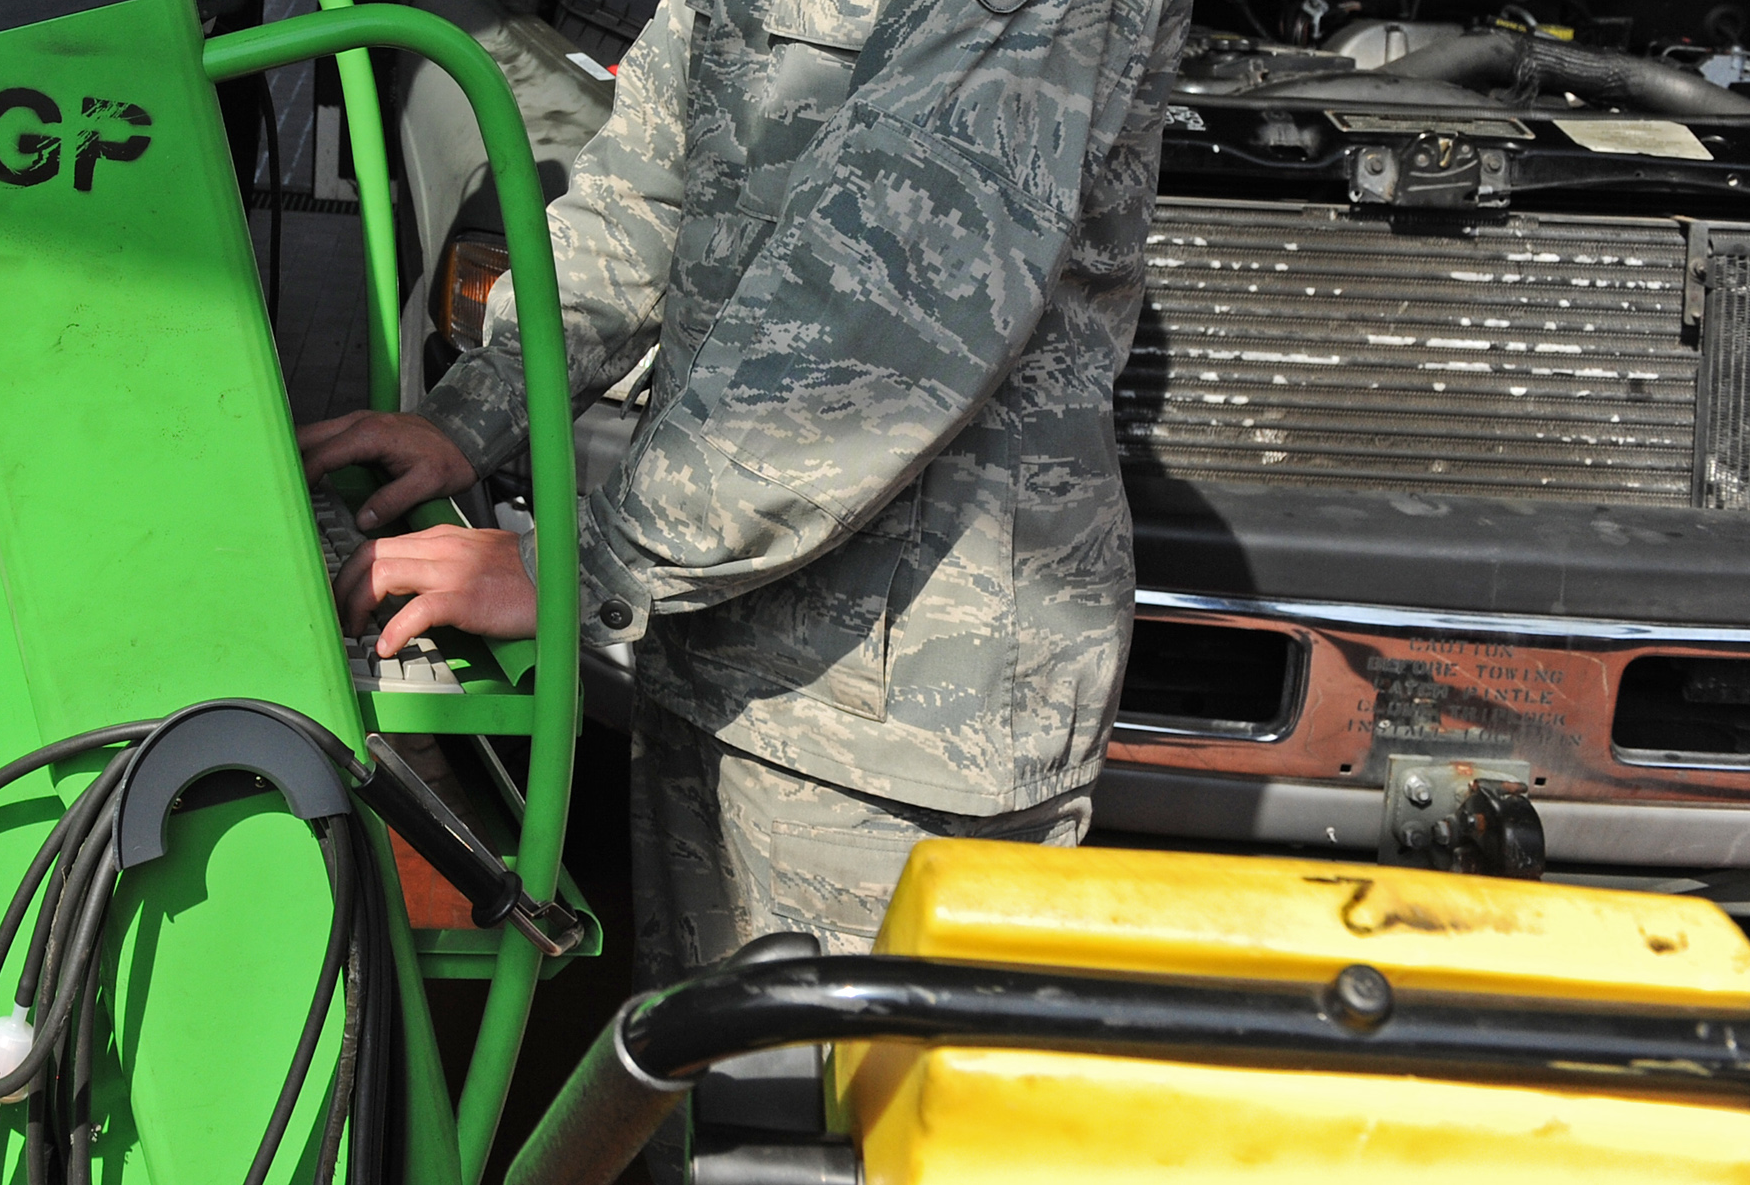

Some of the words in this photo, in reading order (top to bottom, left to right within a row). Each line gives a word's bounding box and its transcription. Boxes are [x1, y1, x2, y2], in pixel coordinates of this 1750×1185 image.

[1409, 637, 1514, 658] CAUTION
[1367, 657, 1458, 677] BEFORE
[1475, 664, 1564, 684] TOWING
[1463, 686, 1554, 705] PINTLE
